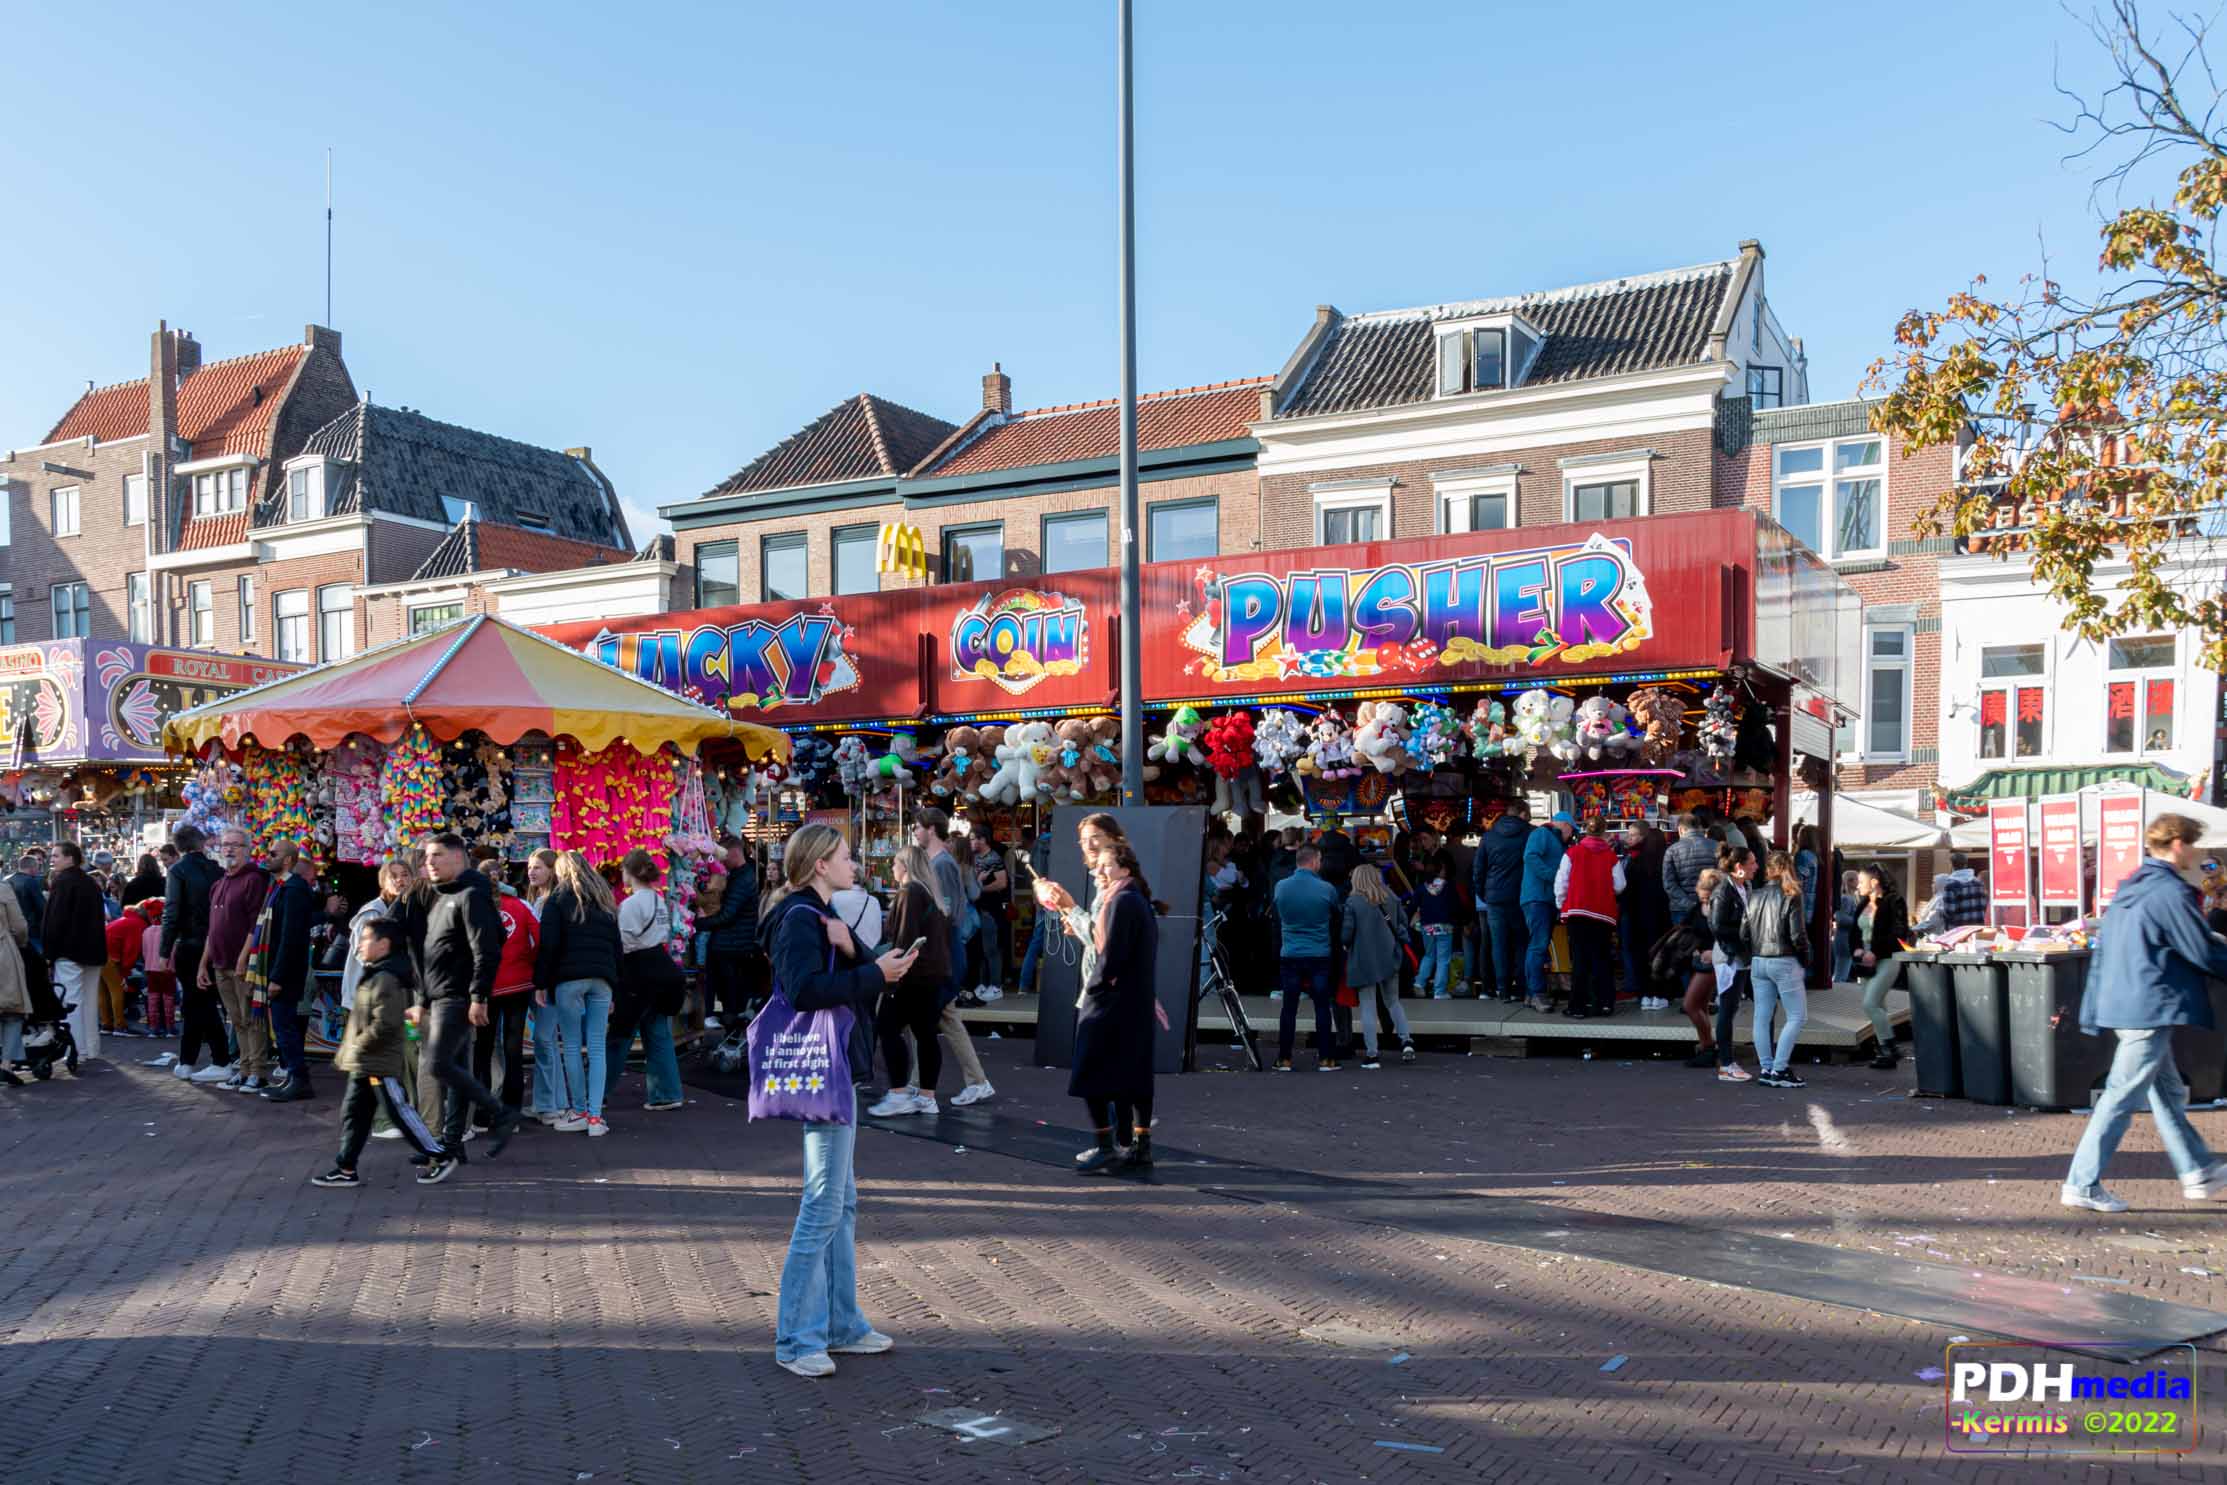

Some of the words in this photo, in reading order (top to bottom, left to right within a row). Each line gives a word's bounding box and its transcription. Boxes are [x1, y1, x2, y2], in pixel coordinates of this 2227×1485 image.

[952, 604, 1085, 675] COIN
[1220, 551, 1634, 668] PUSHER
[0, 652, 41, 670] ASINO
[172, 658, 232, 680] ROYAL
[761, 1059, 773, 1069] at
[774, 1058, 799, 1068] first
[801, 1056, 830, 1070] sight
